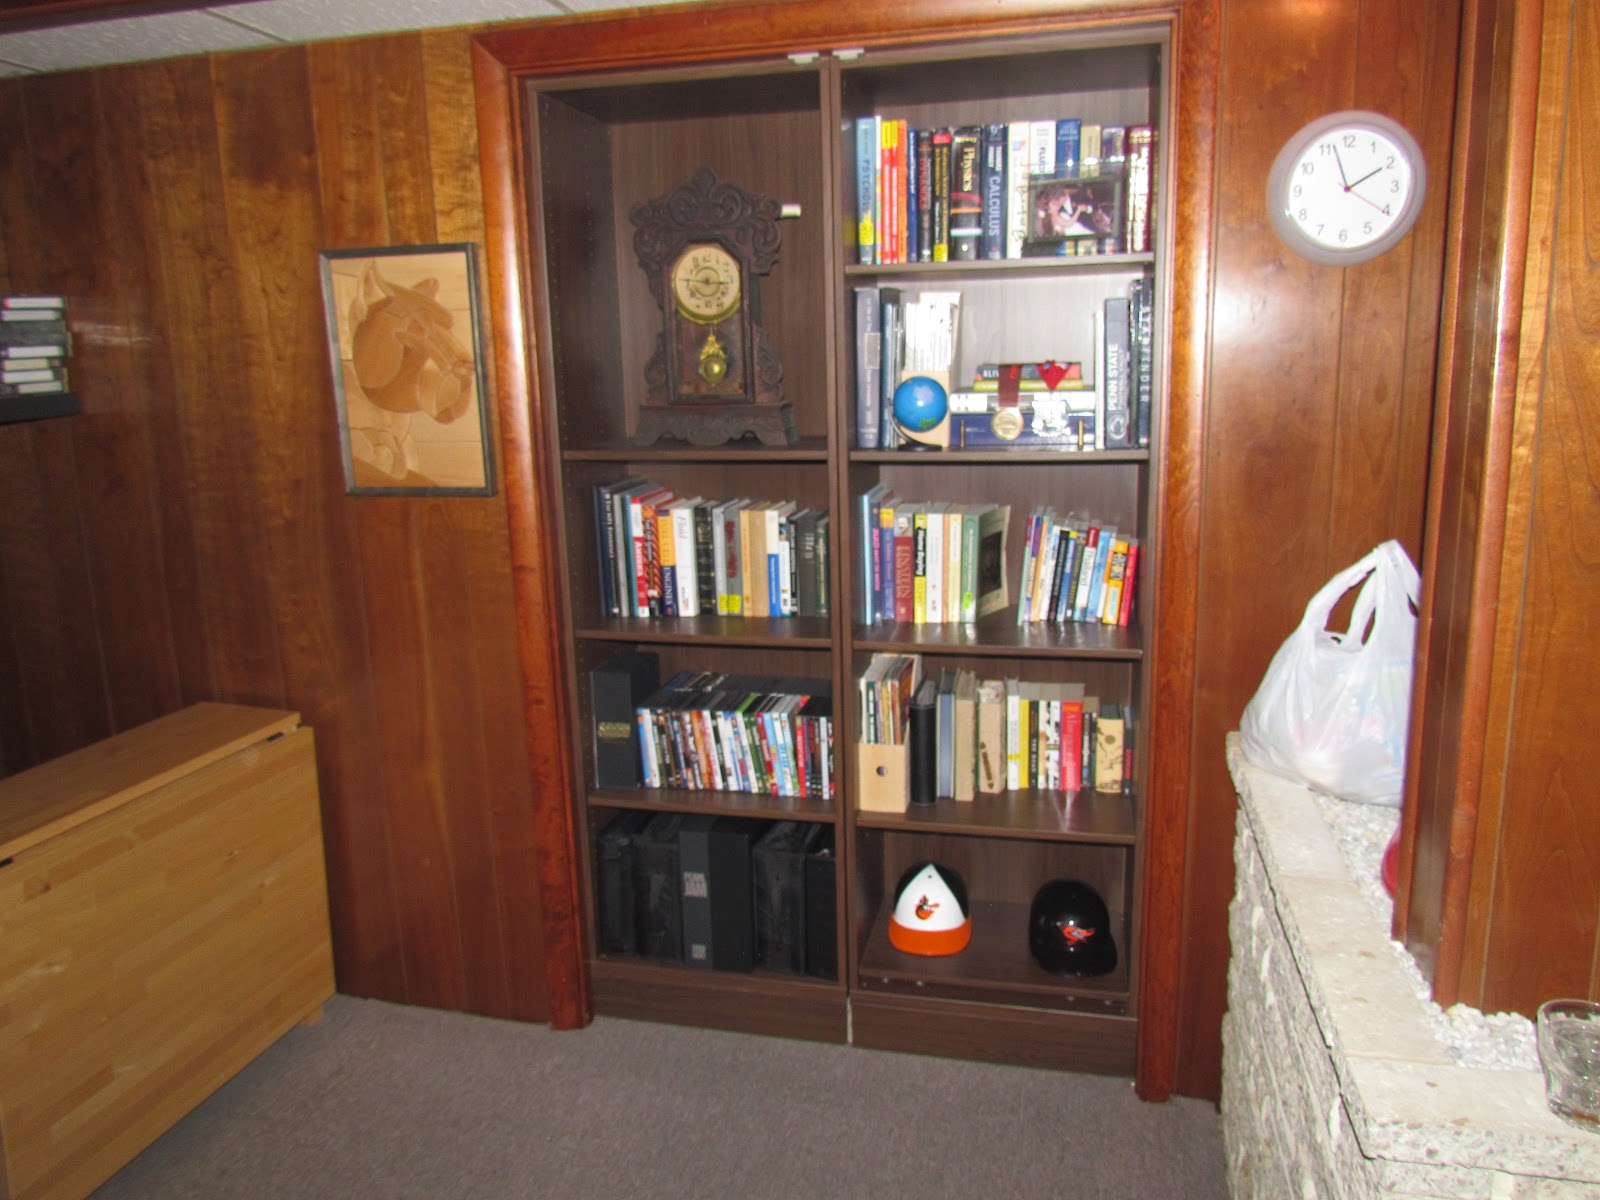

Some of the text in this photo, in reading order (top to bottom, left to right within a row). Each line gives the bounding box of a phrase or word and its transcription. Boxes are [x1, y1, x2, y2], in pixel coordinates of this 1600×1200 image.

[1342, 135, 1356, 148] 12
[1371, 141, 1376, 153] 1
[1319, 144, 1331, 156] 11
[961, 147, 976, 192] Physics
[1301, 161, 1314, 175] 10
[1386, 156, 1395, 169] 2
[1293, 184, 1303, 198] 9
[1390, 180, 1400, 193] 3
[989, 175, 1001, 237] CALCULUS
[1382, 204, 1390, 216] 4
[1298, 208, 1308, 221] 8
[1316, 223, 1325, 237] 7
[1363, 221, 1373, 235] 5
[1338, 229, 1348, 242] 6
[1140, 305, 1151, 403] STARFINDER
[983, 369, 999, 377] ALIV
[1108, 343, 1118, 411] PENN STATE
[916, 530, 925, 577] Home Buying
[900, 545, 911, 598] EINSTEIN
[1081, 550, 1094, 587] Thailand
[663, 566, 673, 606] ENGINES
